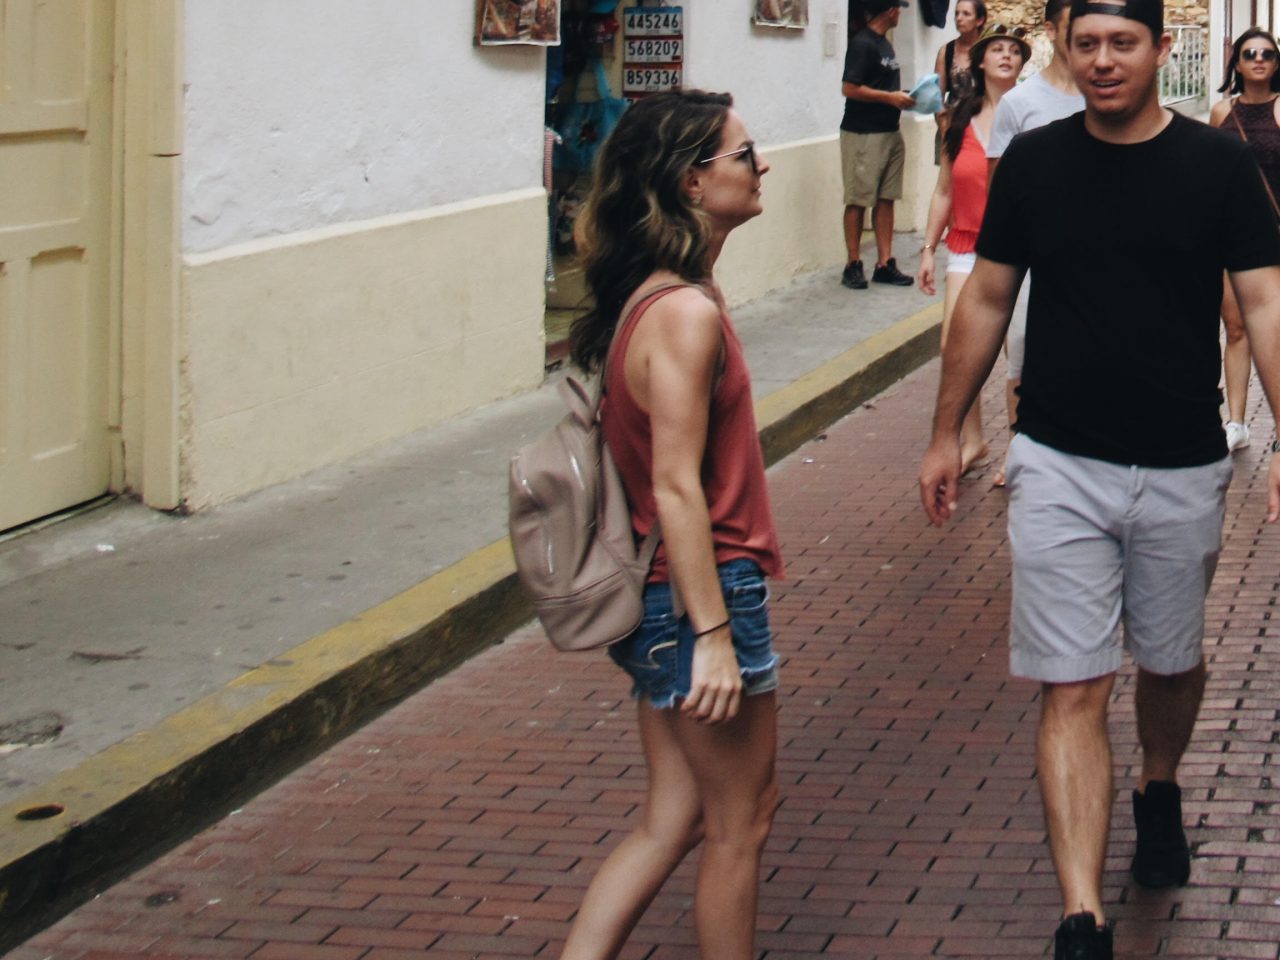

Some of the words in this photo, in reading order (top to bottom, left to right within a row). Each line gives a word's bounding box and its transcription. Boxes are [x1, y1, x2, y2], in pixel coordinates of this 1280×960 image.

[628, 14, 678, 29] 445246
[628, 41, 679, 56] 568209
[627, 70, 678, 85] 859336
